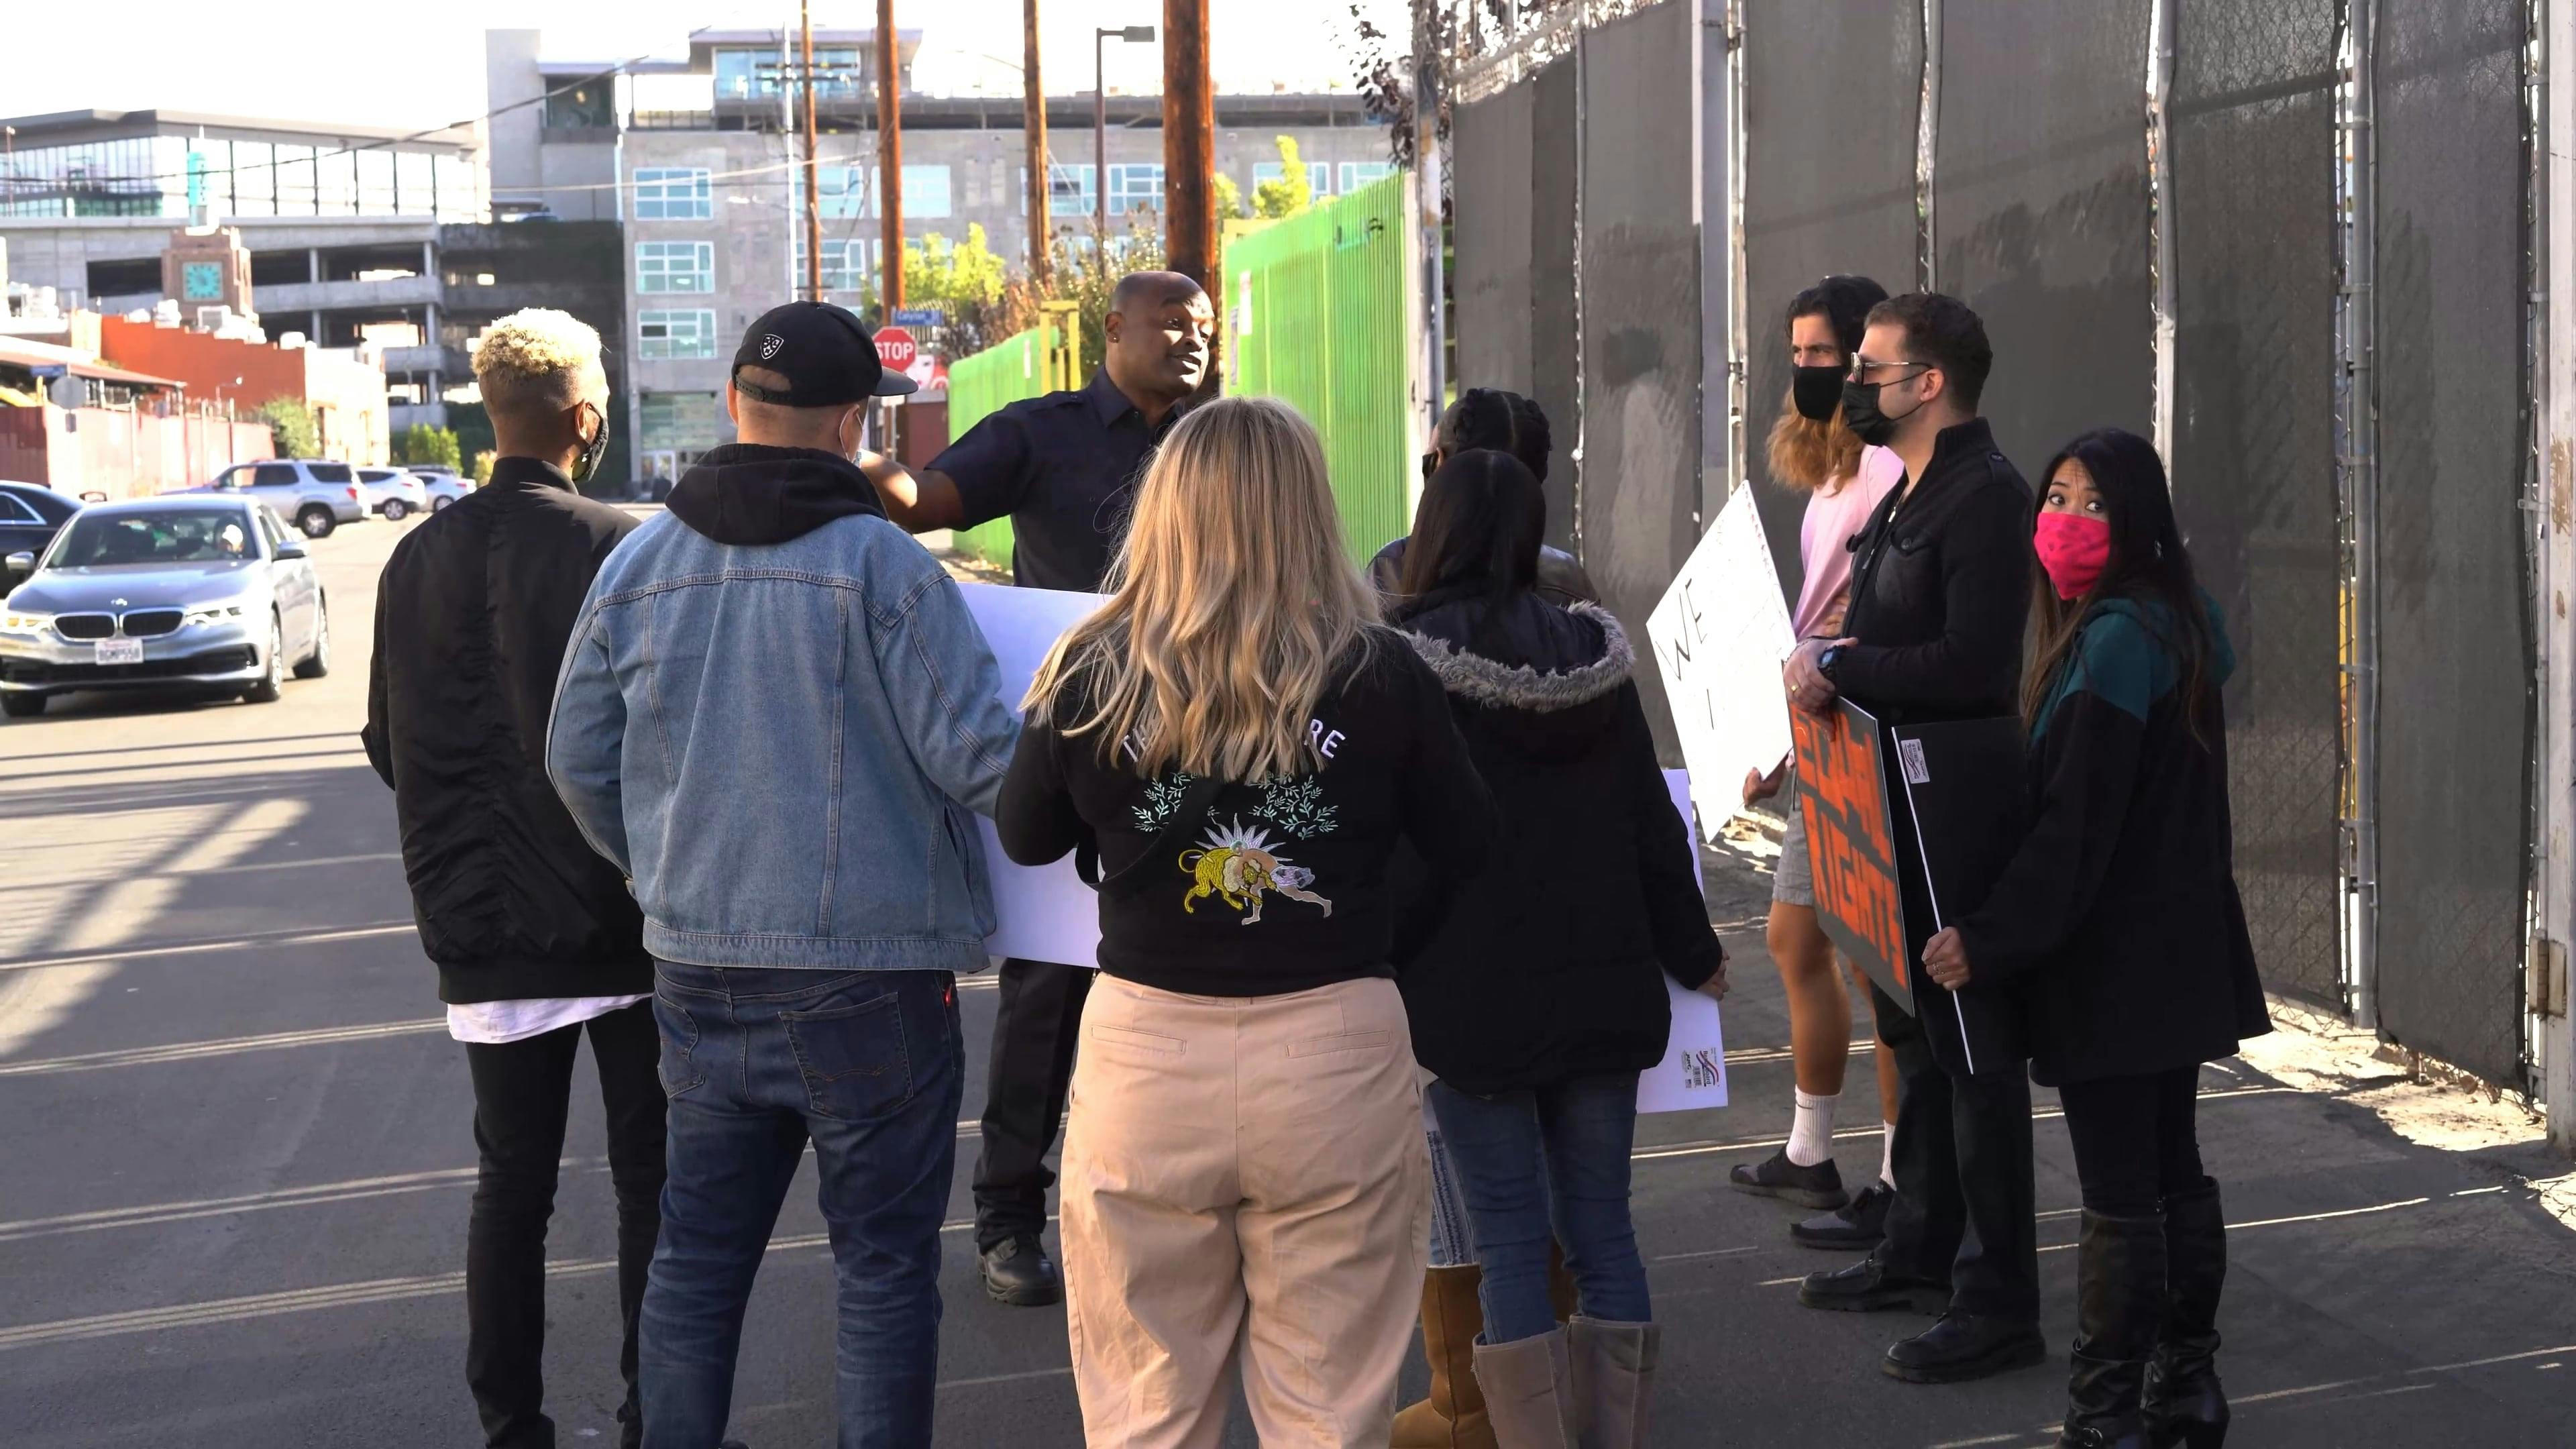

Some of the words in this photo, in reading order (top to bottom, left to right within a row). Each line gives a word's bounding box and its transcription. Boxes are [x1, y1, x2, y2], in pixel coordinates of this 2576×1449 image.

[876, 341, 914, 360] STOP
[1655, 578, 1708, 682] WE
[1791, 701, 1894, 869] EQUAL
[1800, 793, 1909, 991] RIGHTS
